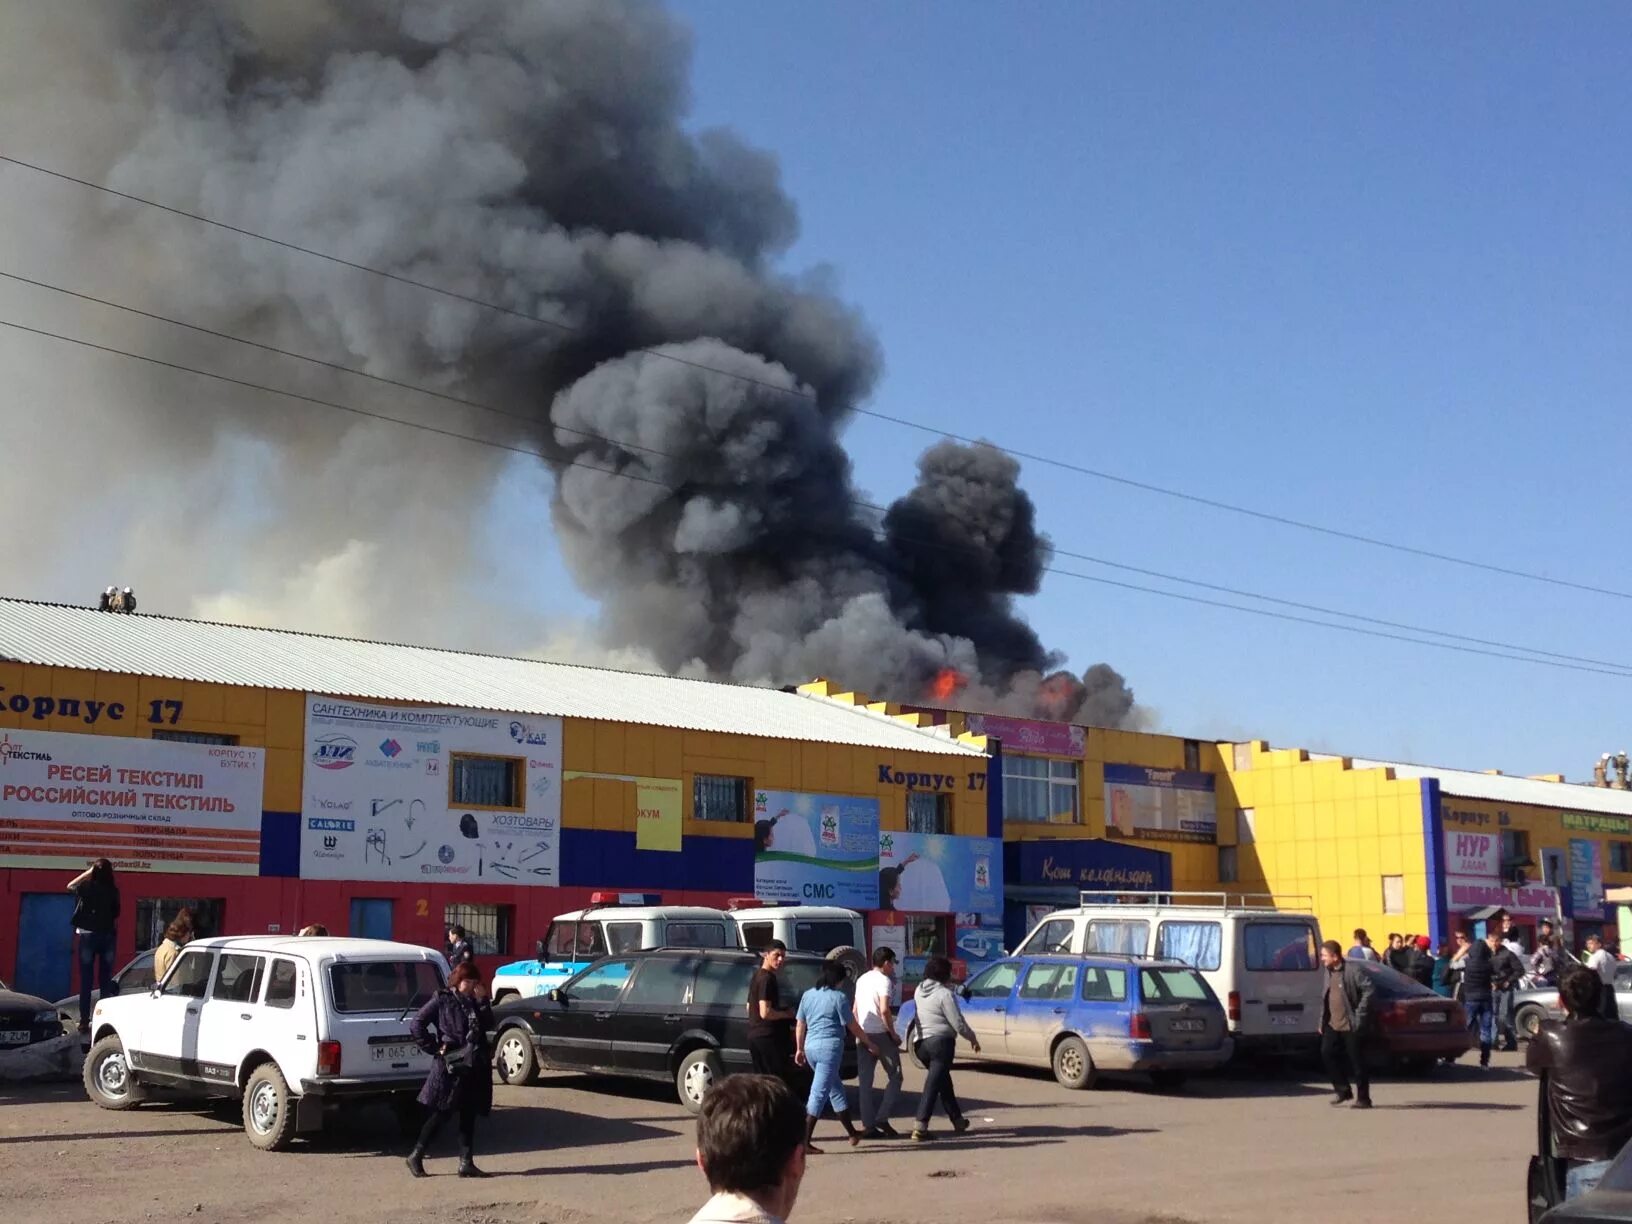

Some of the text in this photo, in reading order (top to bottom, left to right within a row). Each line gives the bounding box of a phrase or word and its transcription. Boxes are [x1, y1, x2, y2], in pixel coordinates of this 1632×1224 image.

[148, 699, 183, 725] 17
[312, 703, 387, 720] САНТЕХНИКА
[390, 711, 398, 720] И
[401, 712, 499, 729] КОМПЛЕКТУЮЩИЕ
[8, 751, 52, 761] ТЕКСТИЛЬ
[208, 749, 245, 759] КОРПУС
[220, 760, 249, 768] БУТИК
[47, 764, 203, 789] РЕСЕЙ ТЕКСТИЛІ
[878, 765, 986, 791] Корпус 17
[3, 784, 235, 813] РОССИЙСКИЙ ТЕКСТИЛЬ
[492, 815, 555, 828] ХОЗТОВАРЫ
[1456, 834, 1490, 857] НУР
[803, 883, 835, 899] СМС
[416, 899, 428, 916] 2
[887, 912, 895, 925] 4
[10, 1031, 29, 1041] ZUM
